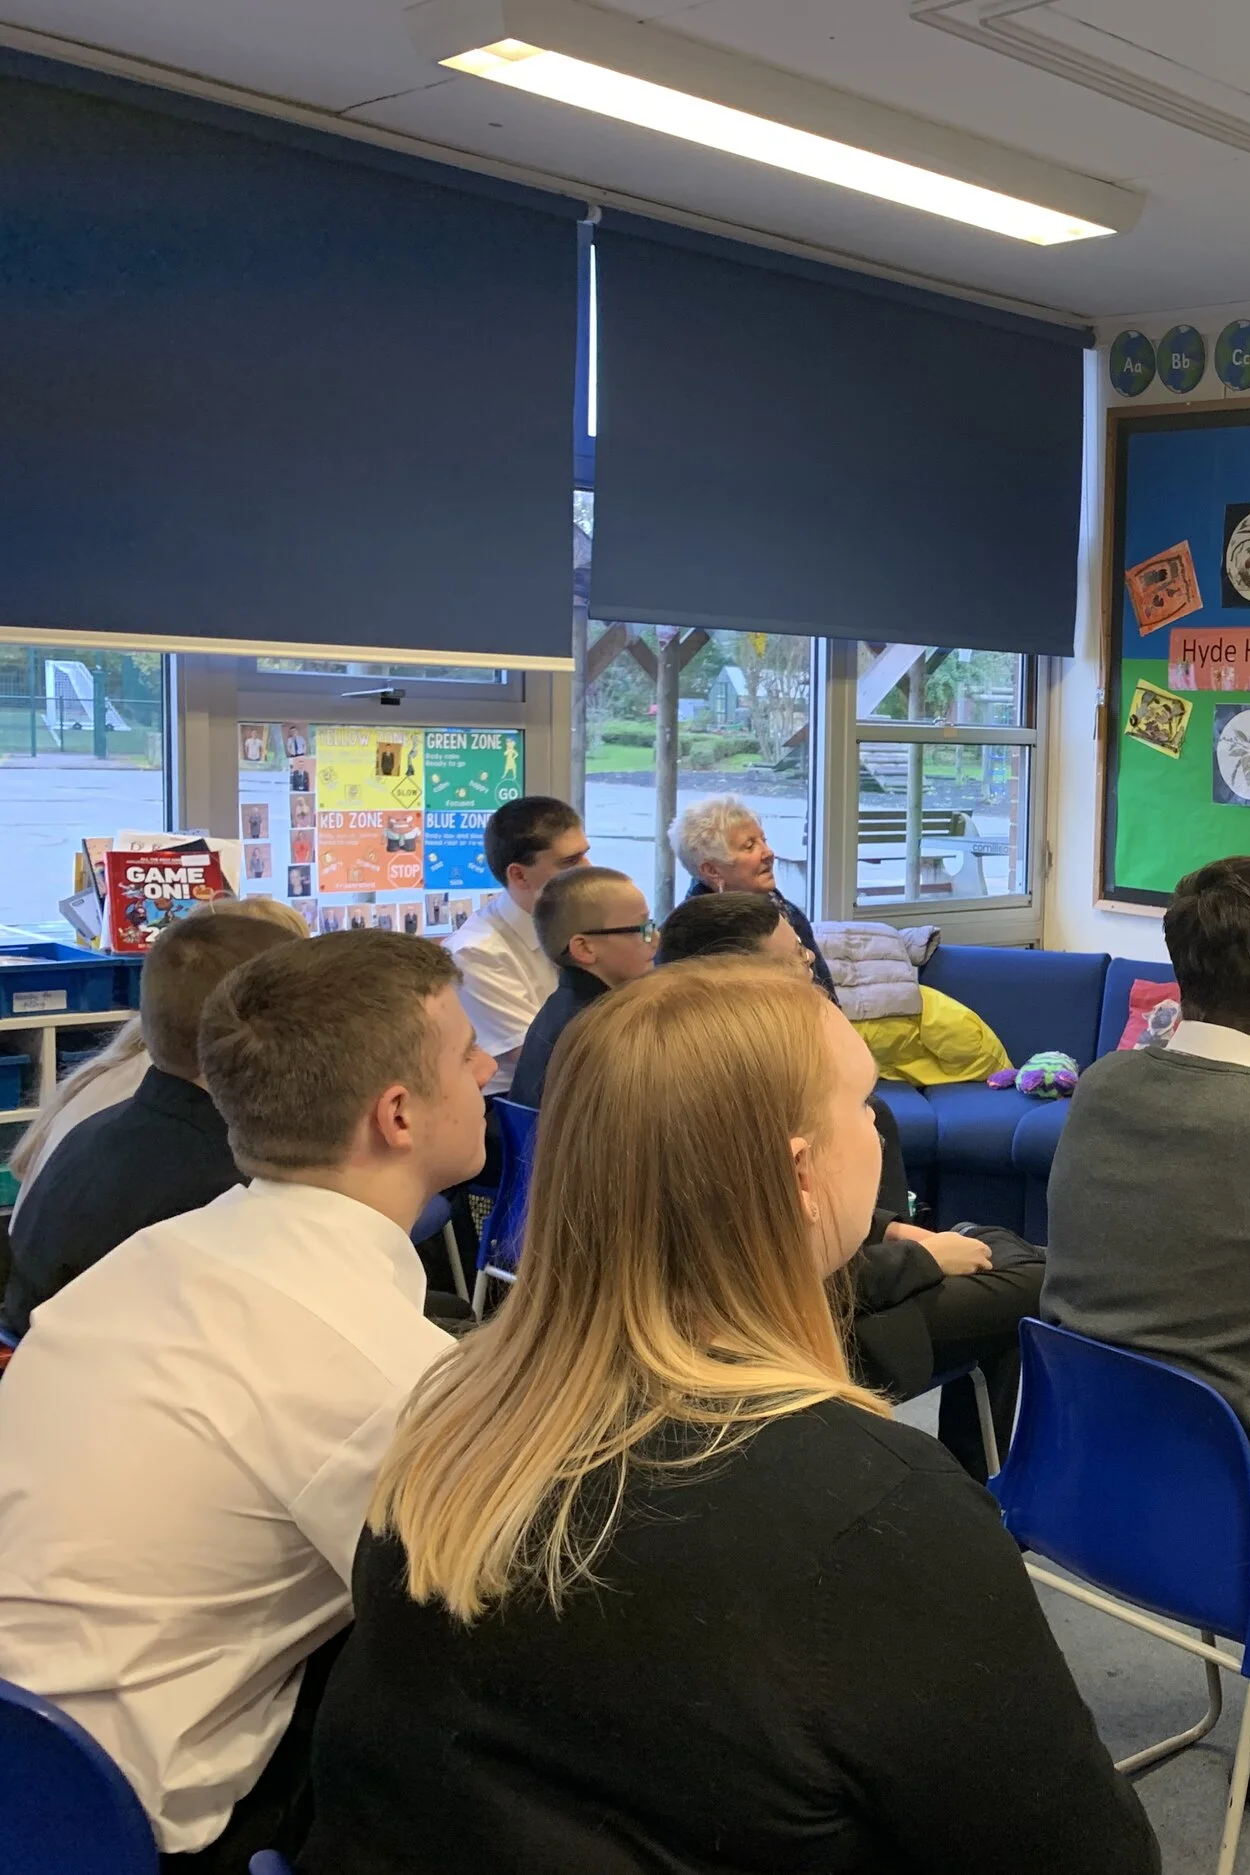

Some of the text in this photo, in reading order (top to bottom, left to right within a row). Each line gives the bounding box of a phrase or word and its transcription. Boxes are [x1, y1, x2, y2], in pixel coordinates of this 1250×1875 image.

[1123, 356, 1143, 374] Aa
[1171, 353, 1190, 370] Bb
[1231, 349, 1250, 366] Cc
[1182, 637, 1237, 668] Hyde
[426, 733, 502, 750] GREEN ZONE
[397, 789, 418, 797] SLOW
[498, 788, 518, 800] GO
[320, 812, 384, 828] RED ZONE
[426, 813, 456, 828] BLUE
[126, 867, 205, 883] GAME
[390, 864, 421, 878] STOP
[143, 883, 190, 900] ON!
